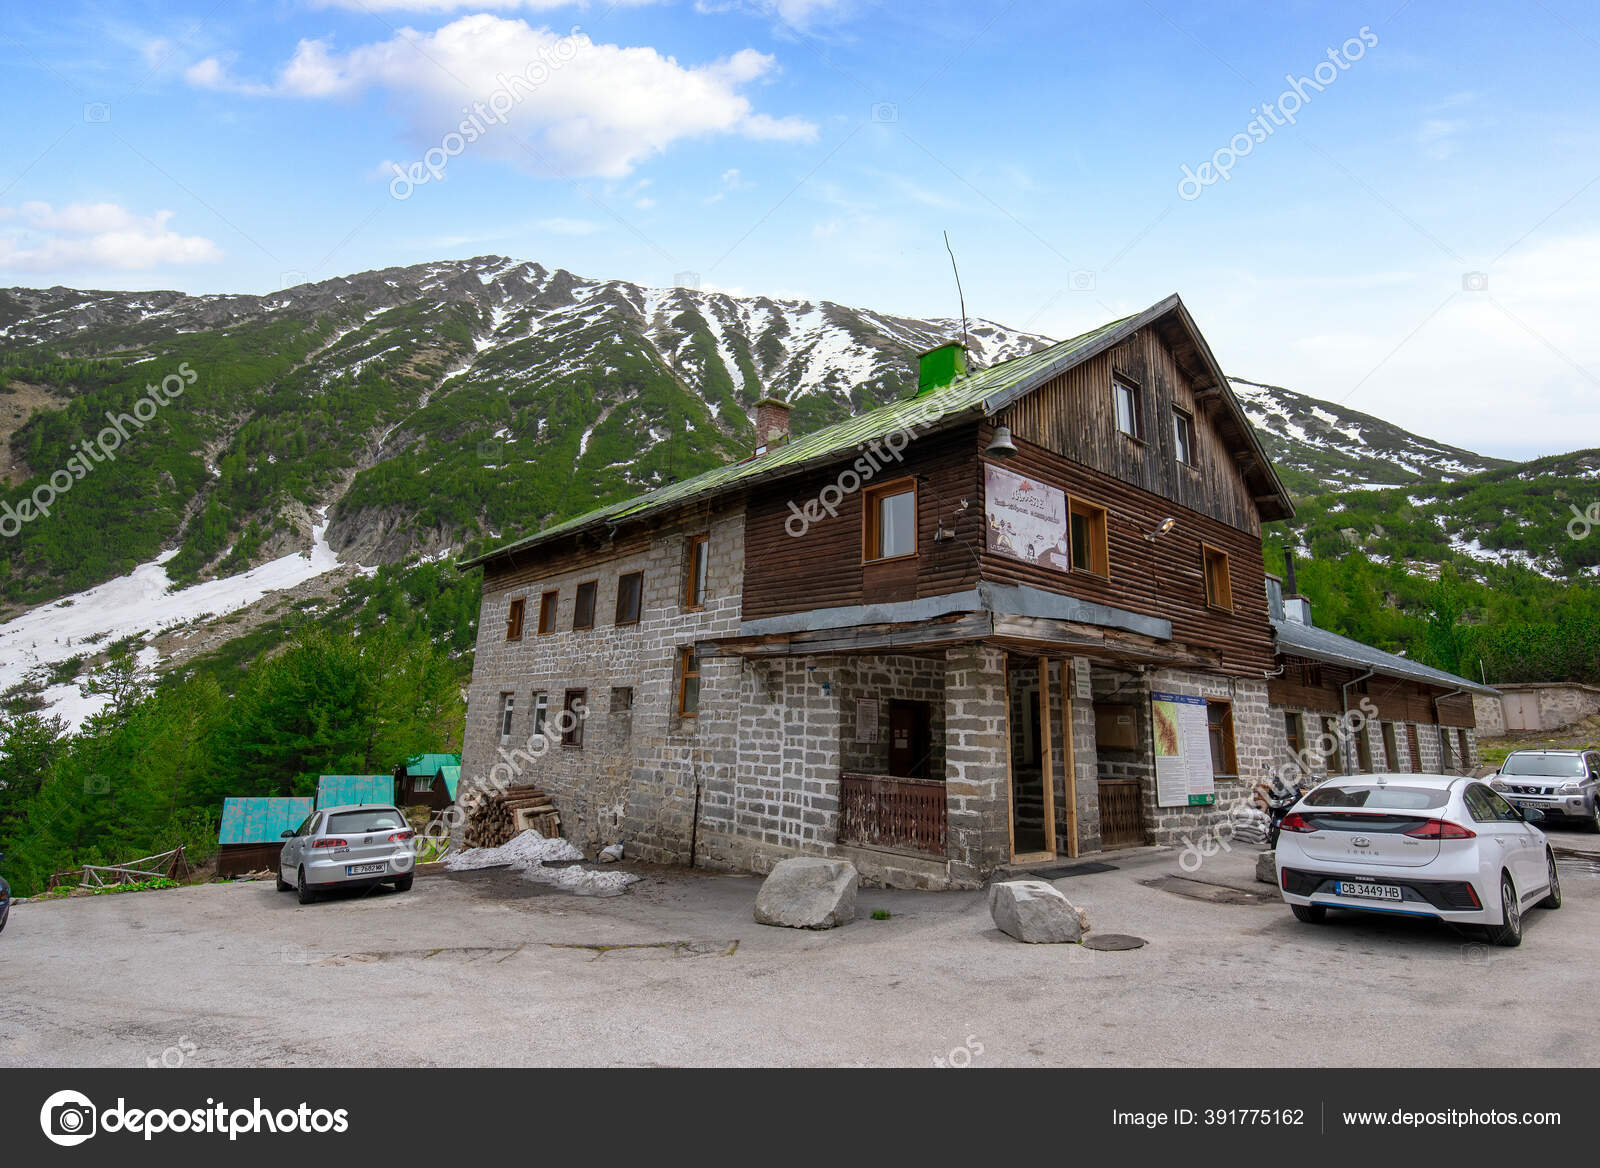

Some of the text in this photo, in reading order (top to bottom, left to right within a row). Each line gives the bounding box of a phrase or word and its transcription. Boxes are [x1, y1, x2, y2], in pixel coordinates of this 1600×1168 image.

[1342, 883, 1400, 898] CB 3449 HB
